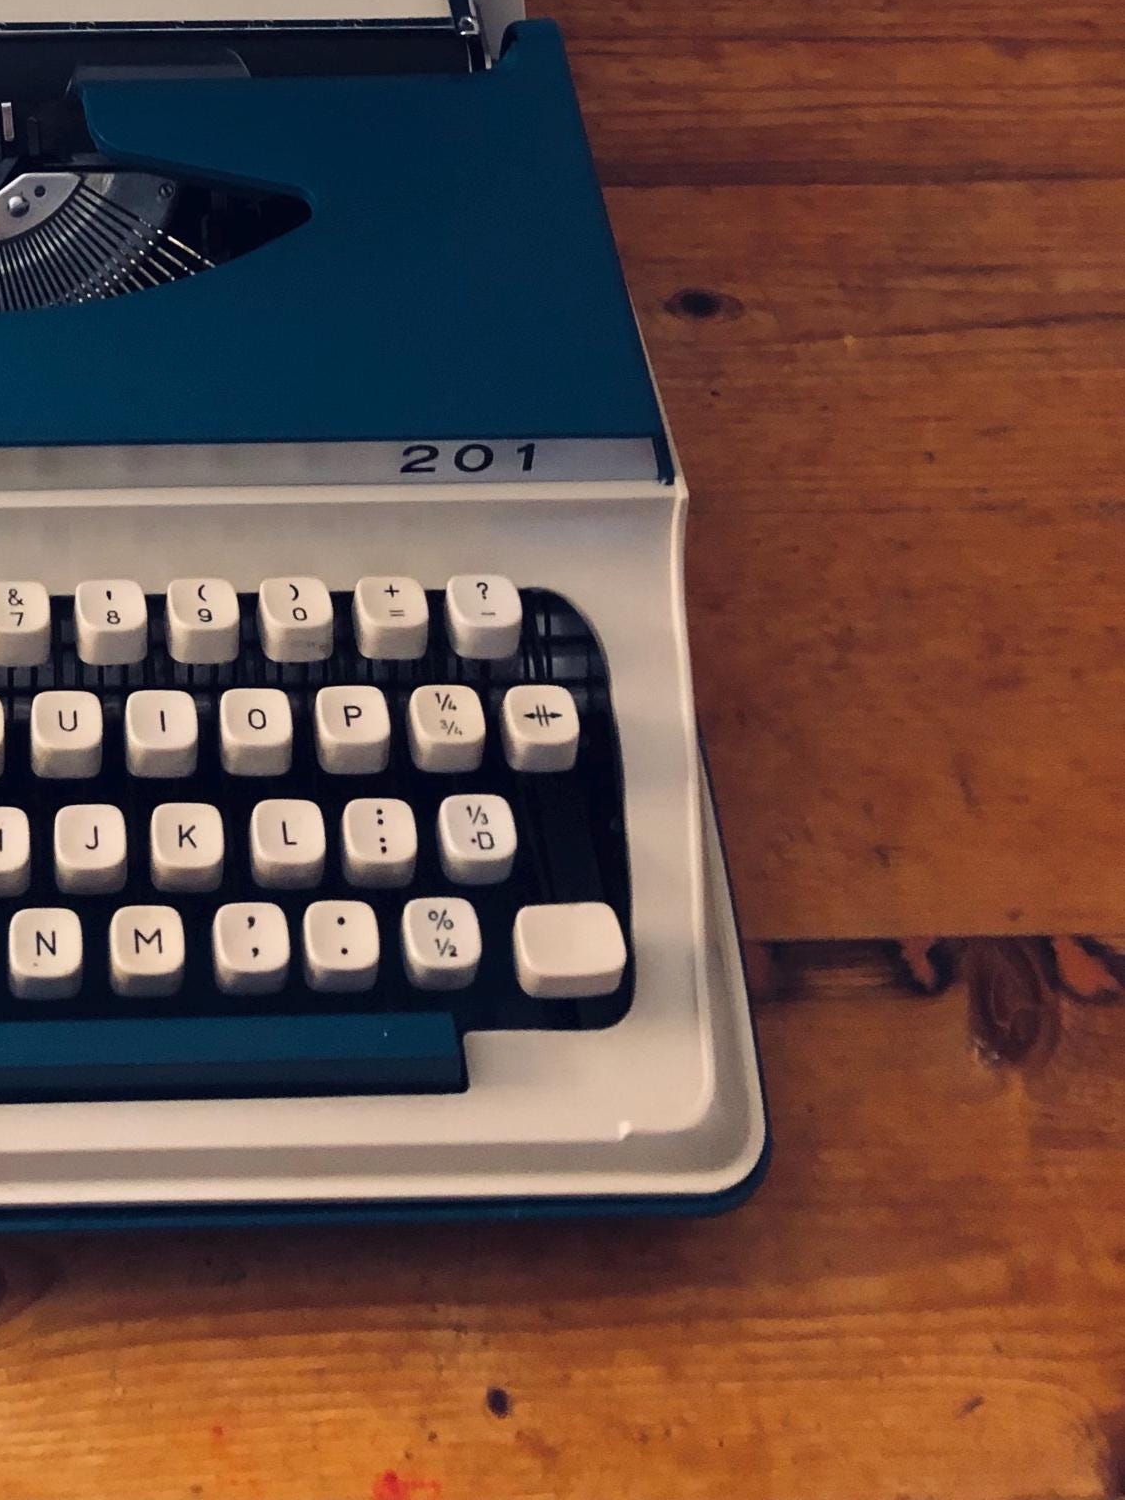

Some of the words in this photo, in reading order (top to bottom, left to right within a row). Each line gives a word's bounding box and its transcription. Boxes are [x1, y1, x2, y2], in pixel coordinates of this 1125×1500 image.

[399, 442, 537, 474] 201
[7, 588, 25, 607] &
[289, 583, 300, 602] )
[384, 584, 400, 598] +
[476, 581, 489, 600] ?
[10, 611, 24, 627] 7
[106, 610, 121, 625] 8
[197, 608, 213, 623] 9
[292, 606, 308, 622] 0
[58, 710, 78, 732] U
[247, 708, 267, 730] O
[343, 705, 363, 728] P
[85, 825, 99, 851] J
[178, 824, 197, 849] K
[281, 820, 298, 846] L
[427, 909, 455, 931] %
[35, 930, 57, 957] N
[133, 928, 163, 955] M
